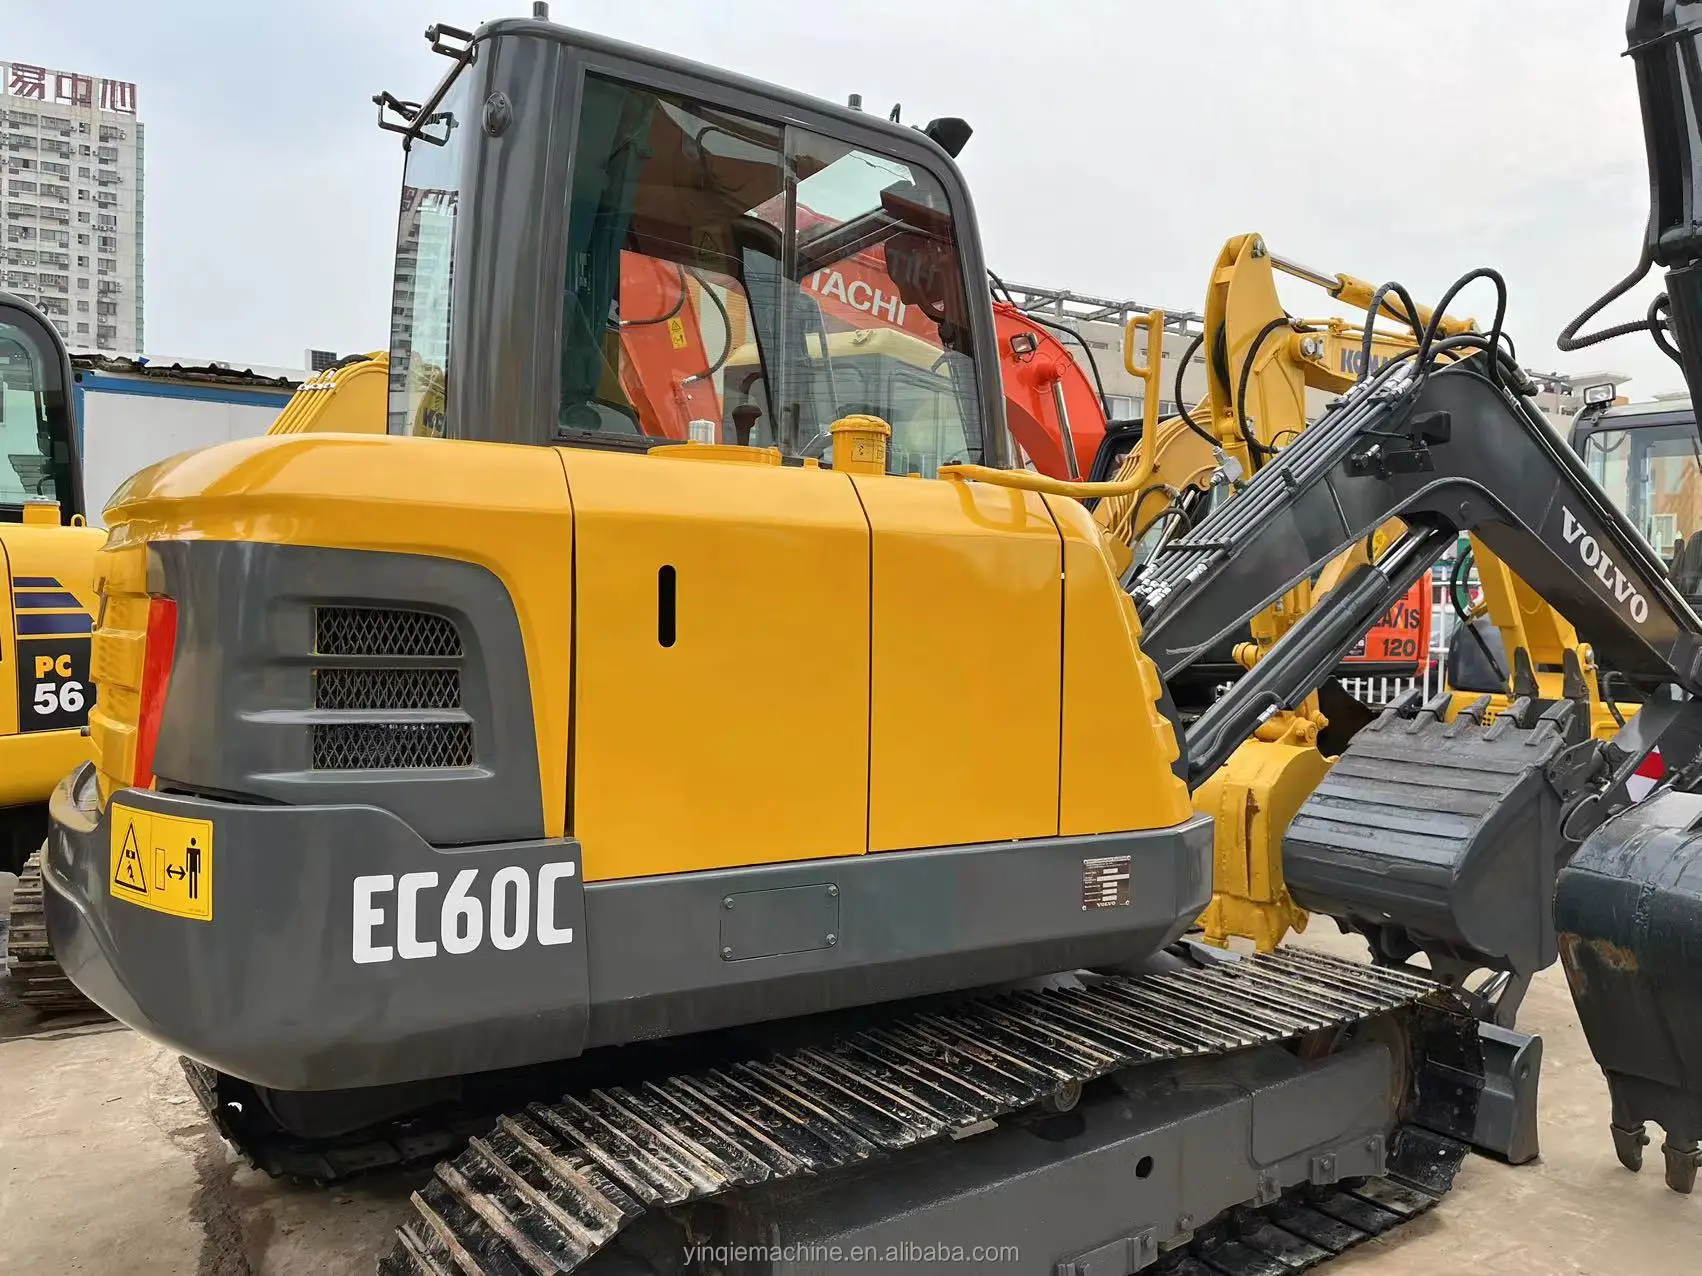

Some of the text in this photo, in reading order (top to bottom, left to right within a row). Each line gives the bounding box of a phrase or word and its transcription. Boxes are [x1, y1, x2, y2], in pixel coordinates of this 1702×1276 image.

[9, 63, 136, 114] 易中心
[1562, 505, 1648, 624] VOLVO
[1372, 602, 1420, 629] AXIS
[1383, 638, 1416, 657] 120
[35, 654, 71, 678] PC
[33, 681, 84, 714] 56
[352, 861, 575, 964] EC60C
